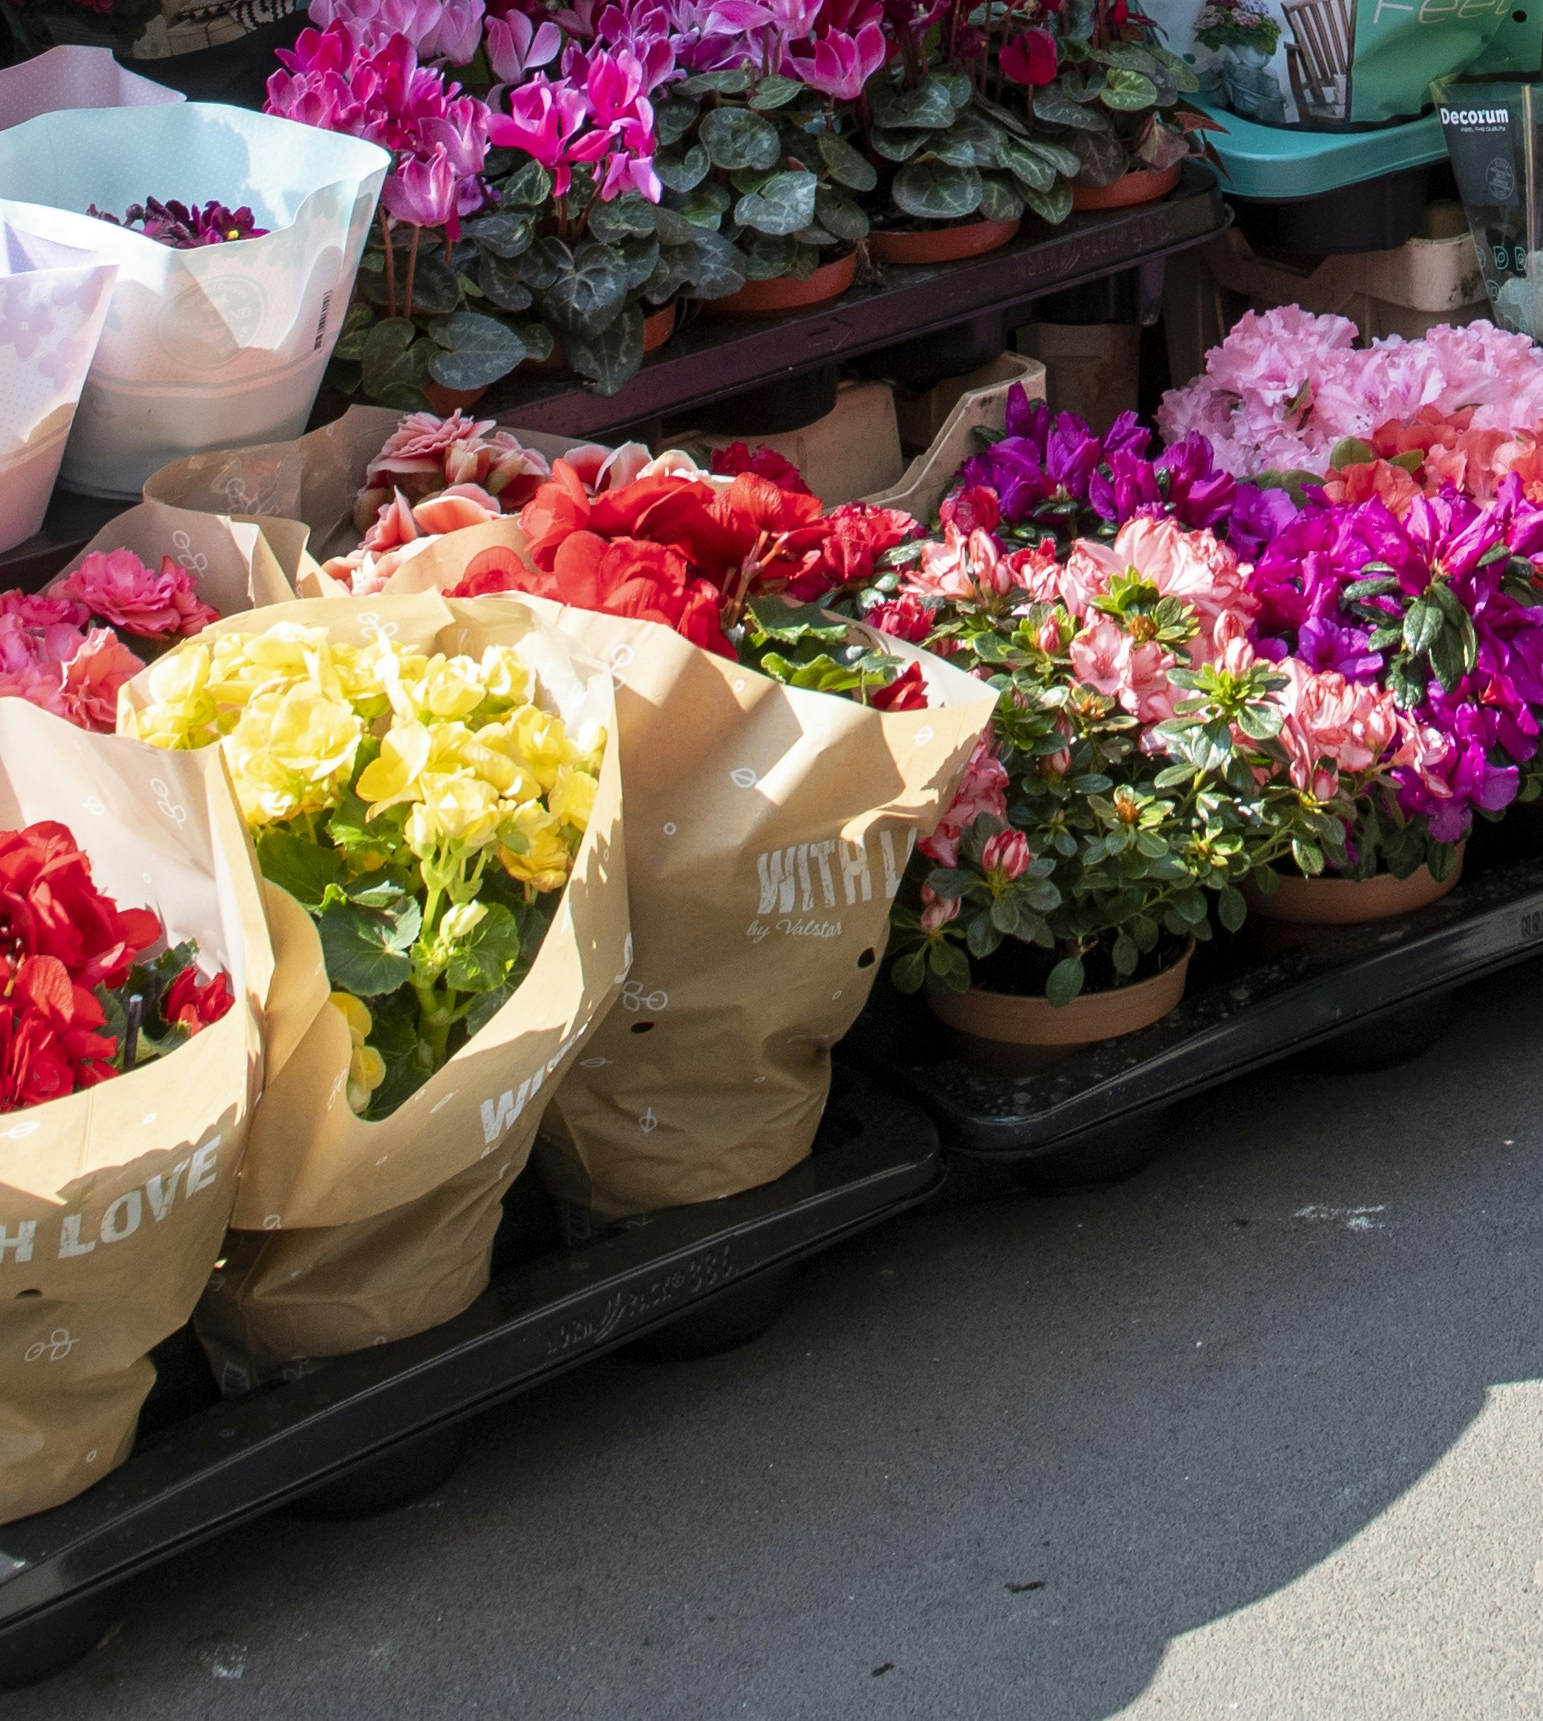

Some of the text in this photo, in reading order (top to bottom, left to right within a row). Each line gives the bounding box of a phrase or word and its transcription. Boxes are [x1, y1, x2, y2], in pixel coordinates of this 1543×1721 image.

[1440, 108, 1508, 125] Decorum
[757, 839, 873, 915] WITH
[746, 919, 844, 944] by Valstar
[57, 1134, 222, 1260] LOVE
